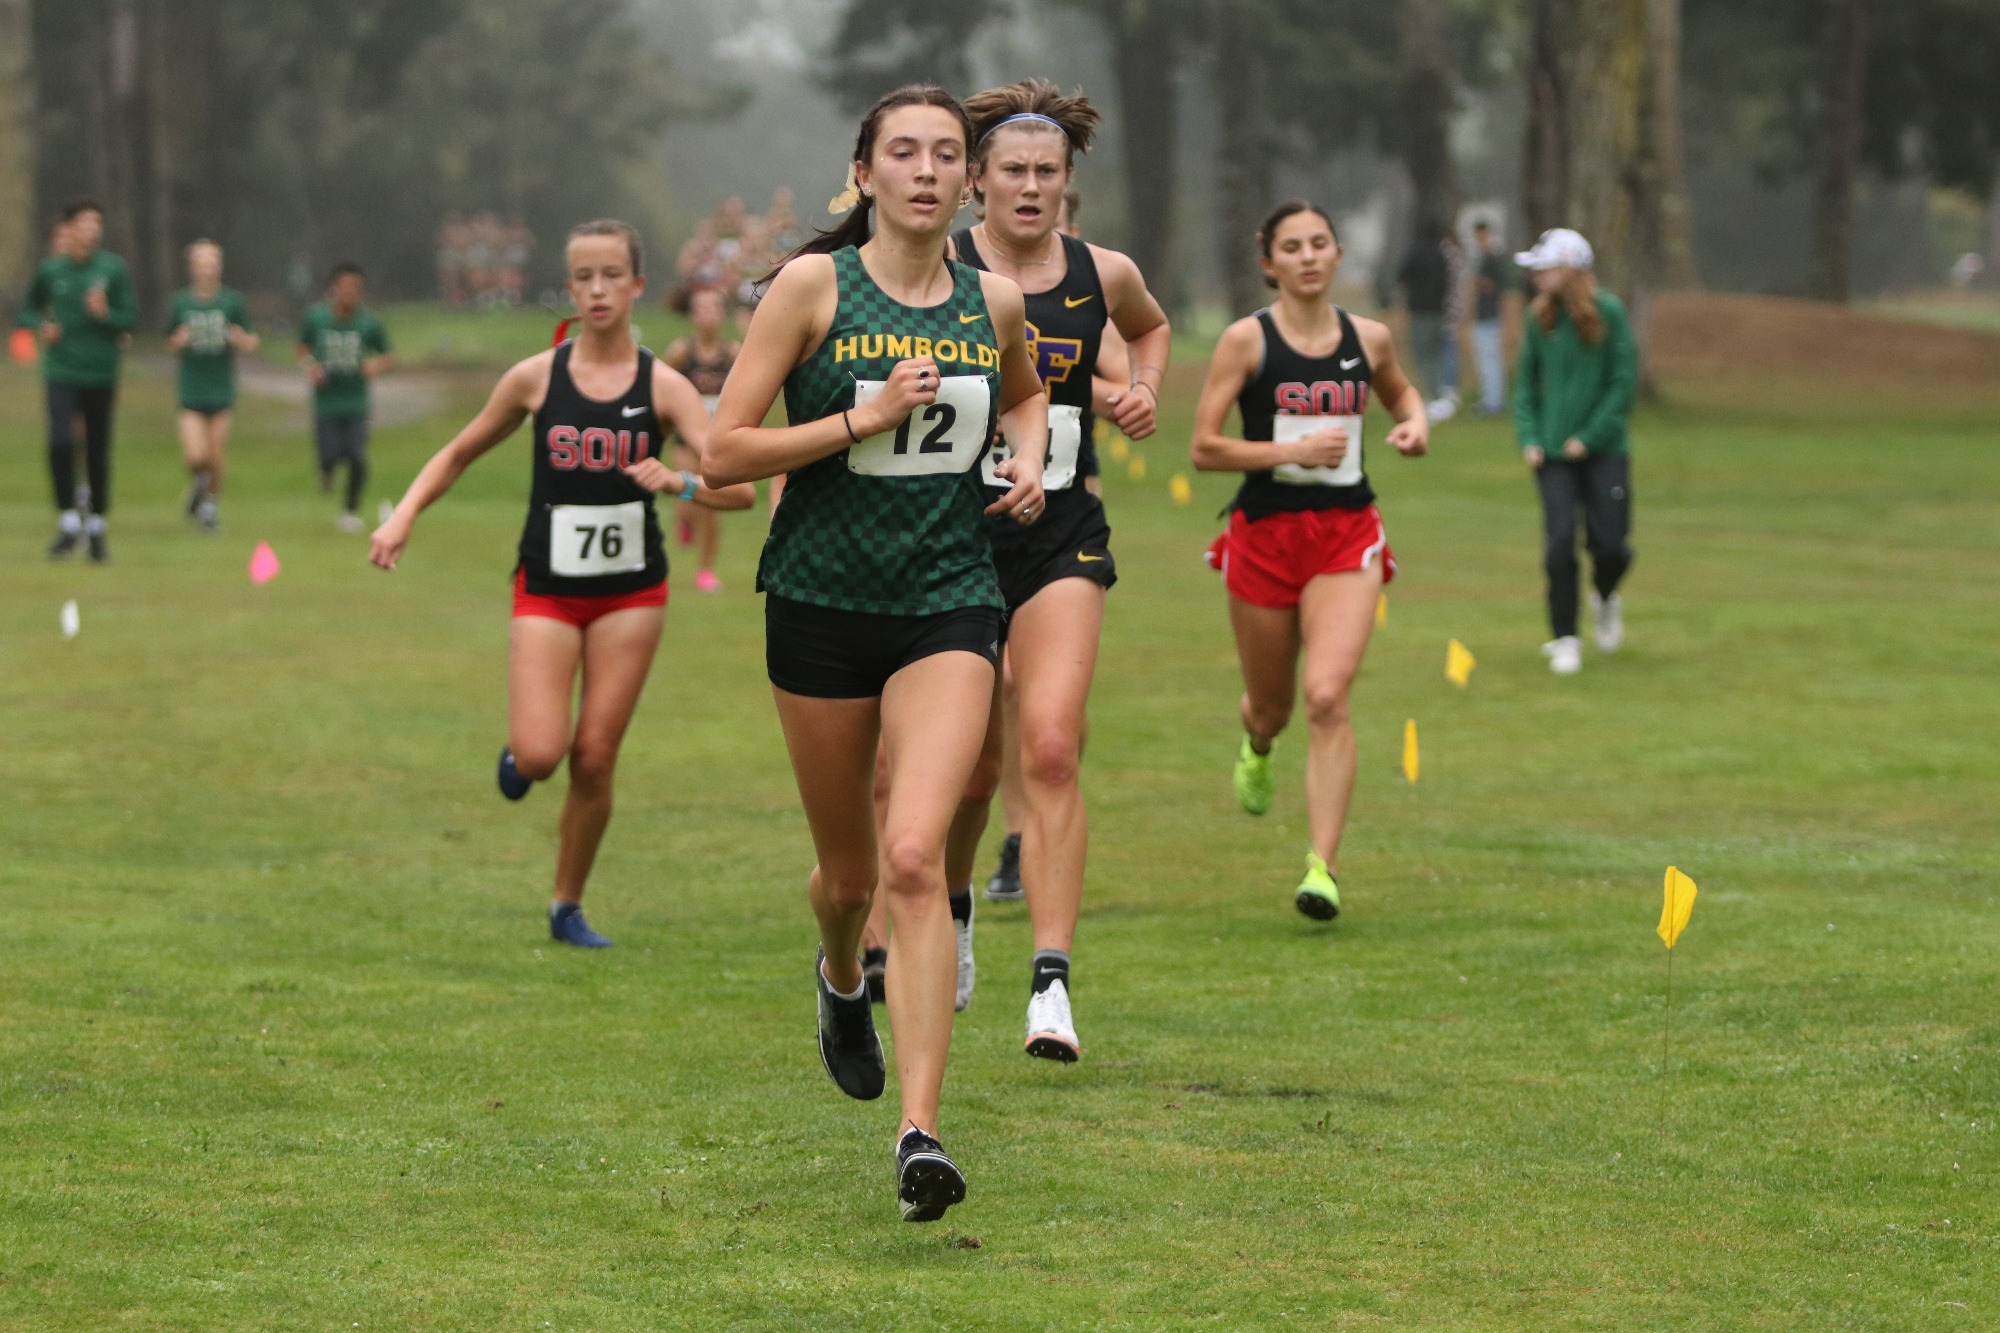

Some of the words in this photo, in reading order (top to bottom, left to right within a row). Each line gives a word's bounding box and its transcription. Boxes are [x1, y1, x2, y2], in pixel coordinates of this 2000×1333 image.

[1274, 380, 1368, 416] SOU
[547, 424, 650, 472] SOU
[893, 402, 957, 455] 12
[575, 523, 624, 560] 76
